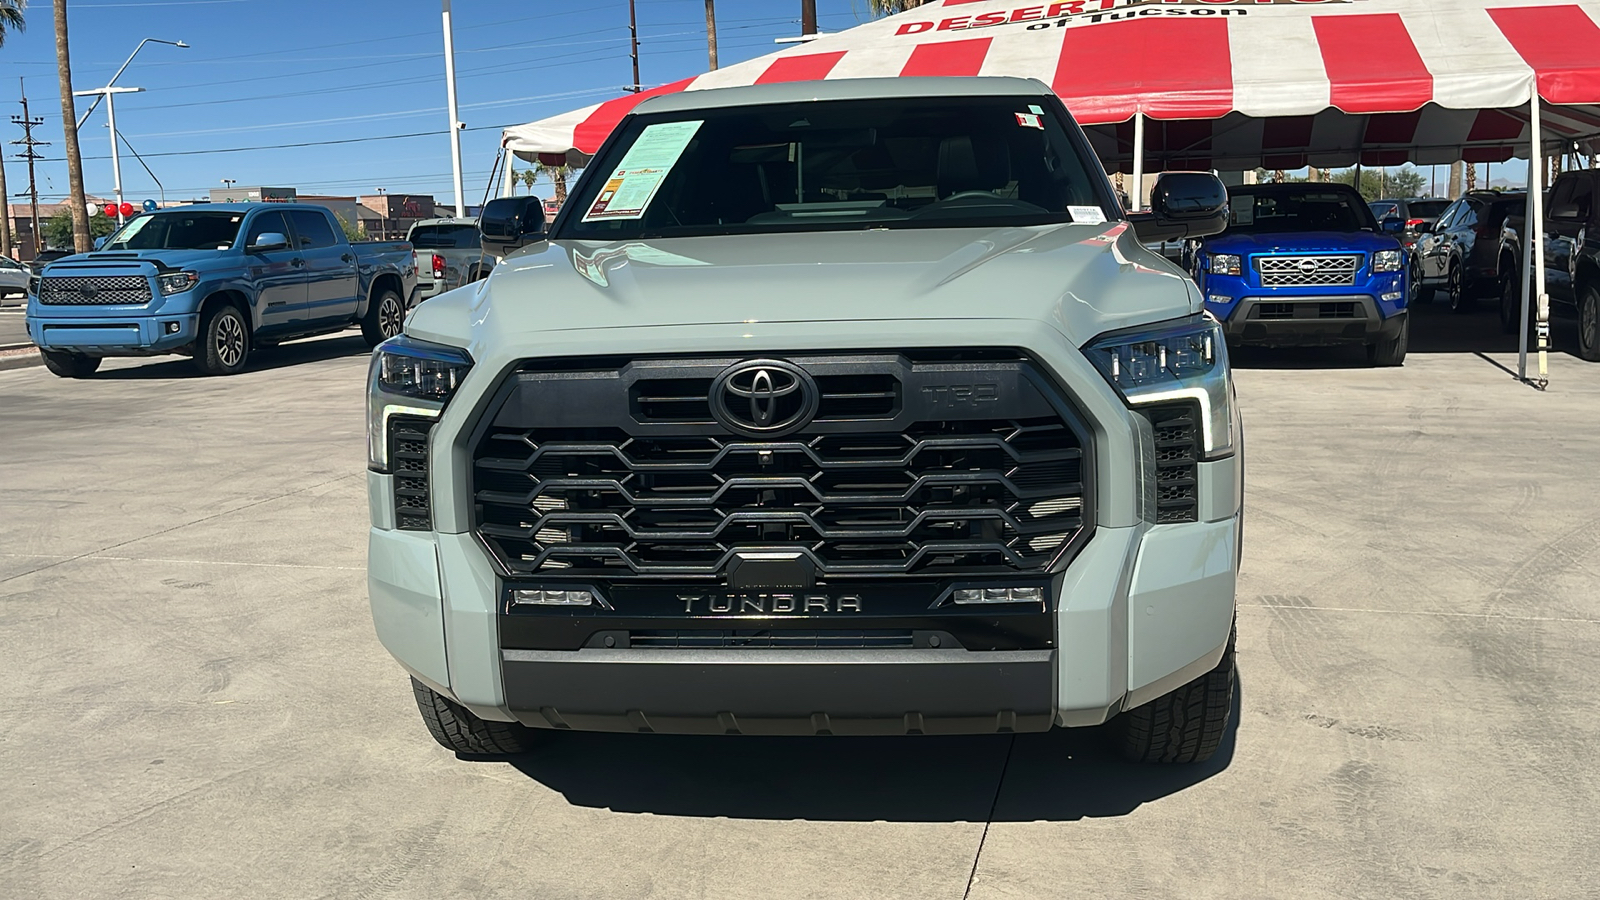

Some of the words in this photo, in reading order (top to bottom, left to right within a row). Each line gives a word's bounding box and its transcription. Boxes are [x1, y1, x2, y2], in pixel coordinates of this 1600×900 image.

[895, 0, 1117, 36] DESERT
[1026, 19, 1073, 31] of
[1082, 8, 1248, 23] Tucson
[921, 384, 999, 407] TRD
[676, 594, 862, 613] TUNDRA
